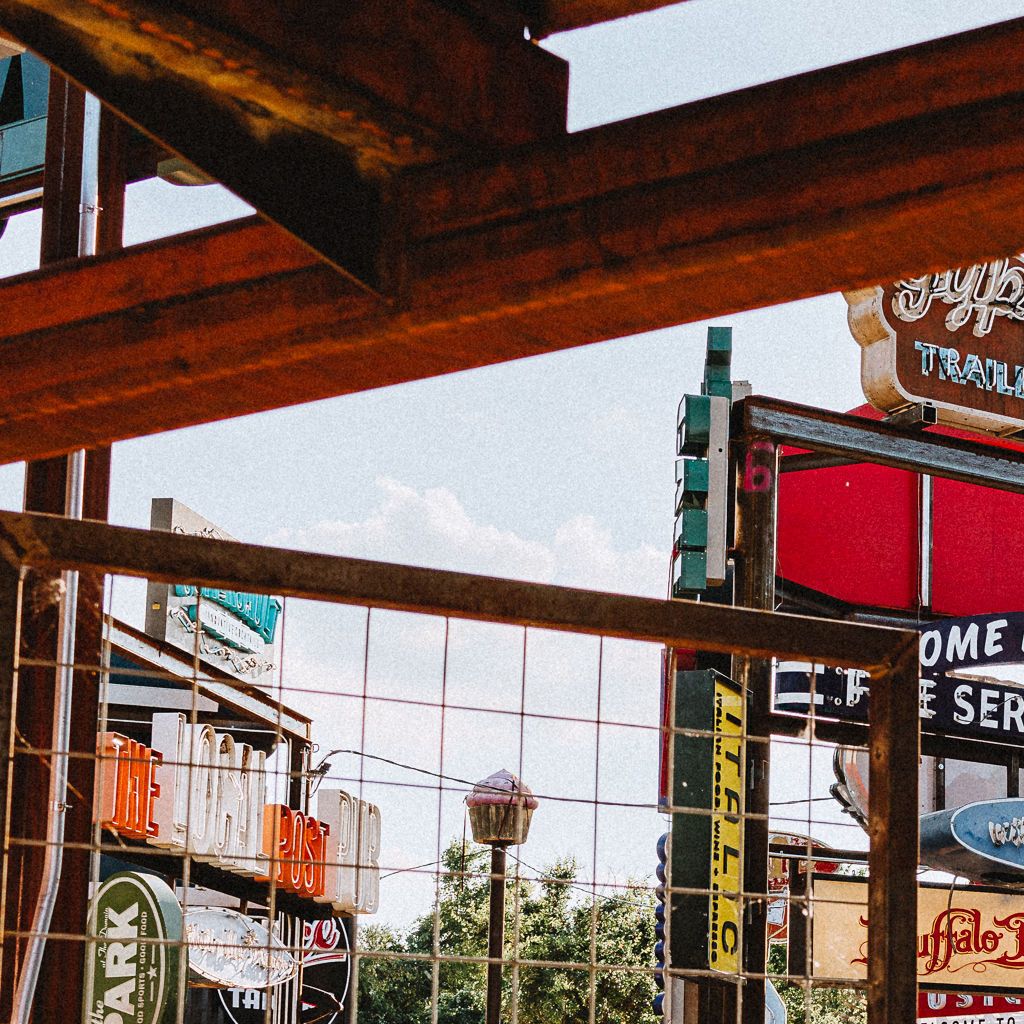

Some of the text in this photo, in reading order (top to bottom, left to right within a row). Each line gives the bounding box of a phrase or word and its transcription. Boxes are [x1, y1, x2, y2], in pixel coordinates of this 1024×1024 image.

[264, 803, 330, 898] POST
[713, 820, 721, 862] WINE
[721, 711, 743, 957] ITALIC
[140, 911, 148, 936] FOOD
[137, 972, 146, 1008] SPORTS
